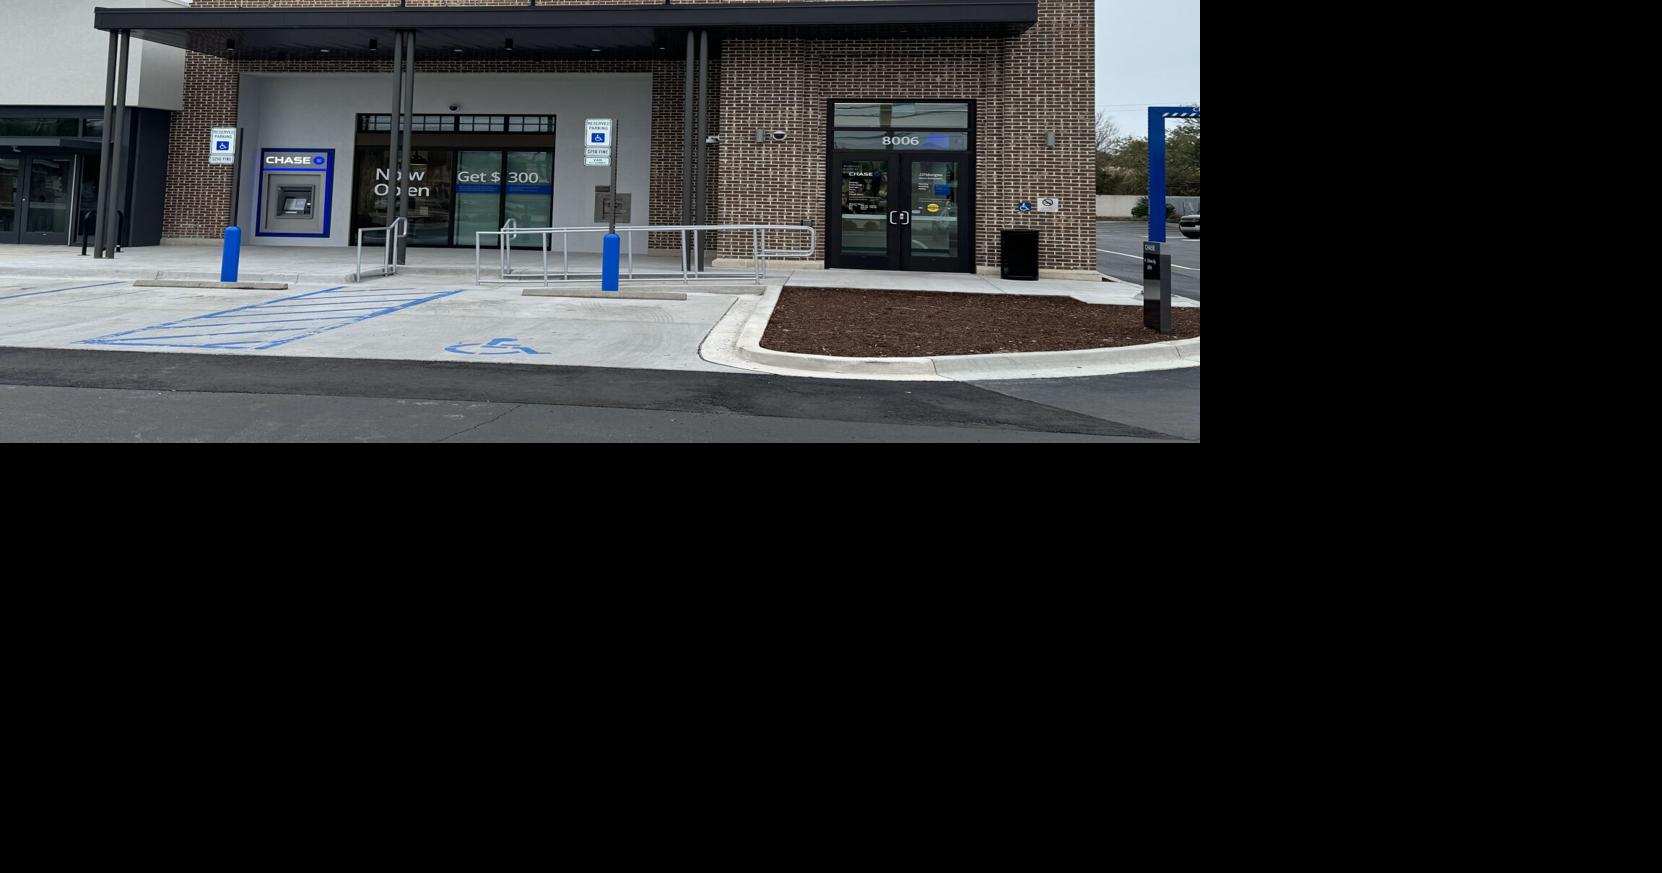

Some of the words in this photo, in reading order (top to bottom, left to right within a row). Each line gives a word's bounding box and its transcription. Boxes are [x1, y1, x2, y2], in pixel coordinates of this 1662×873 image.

[882, 136, 919, 145] 8006
[266, 156, 311, 164] CHASE
[457, 171, 487, 183] Get
